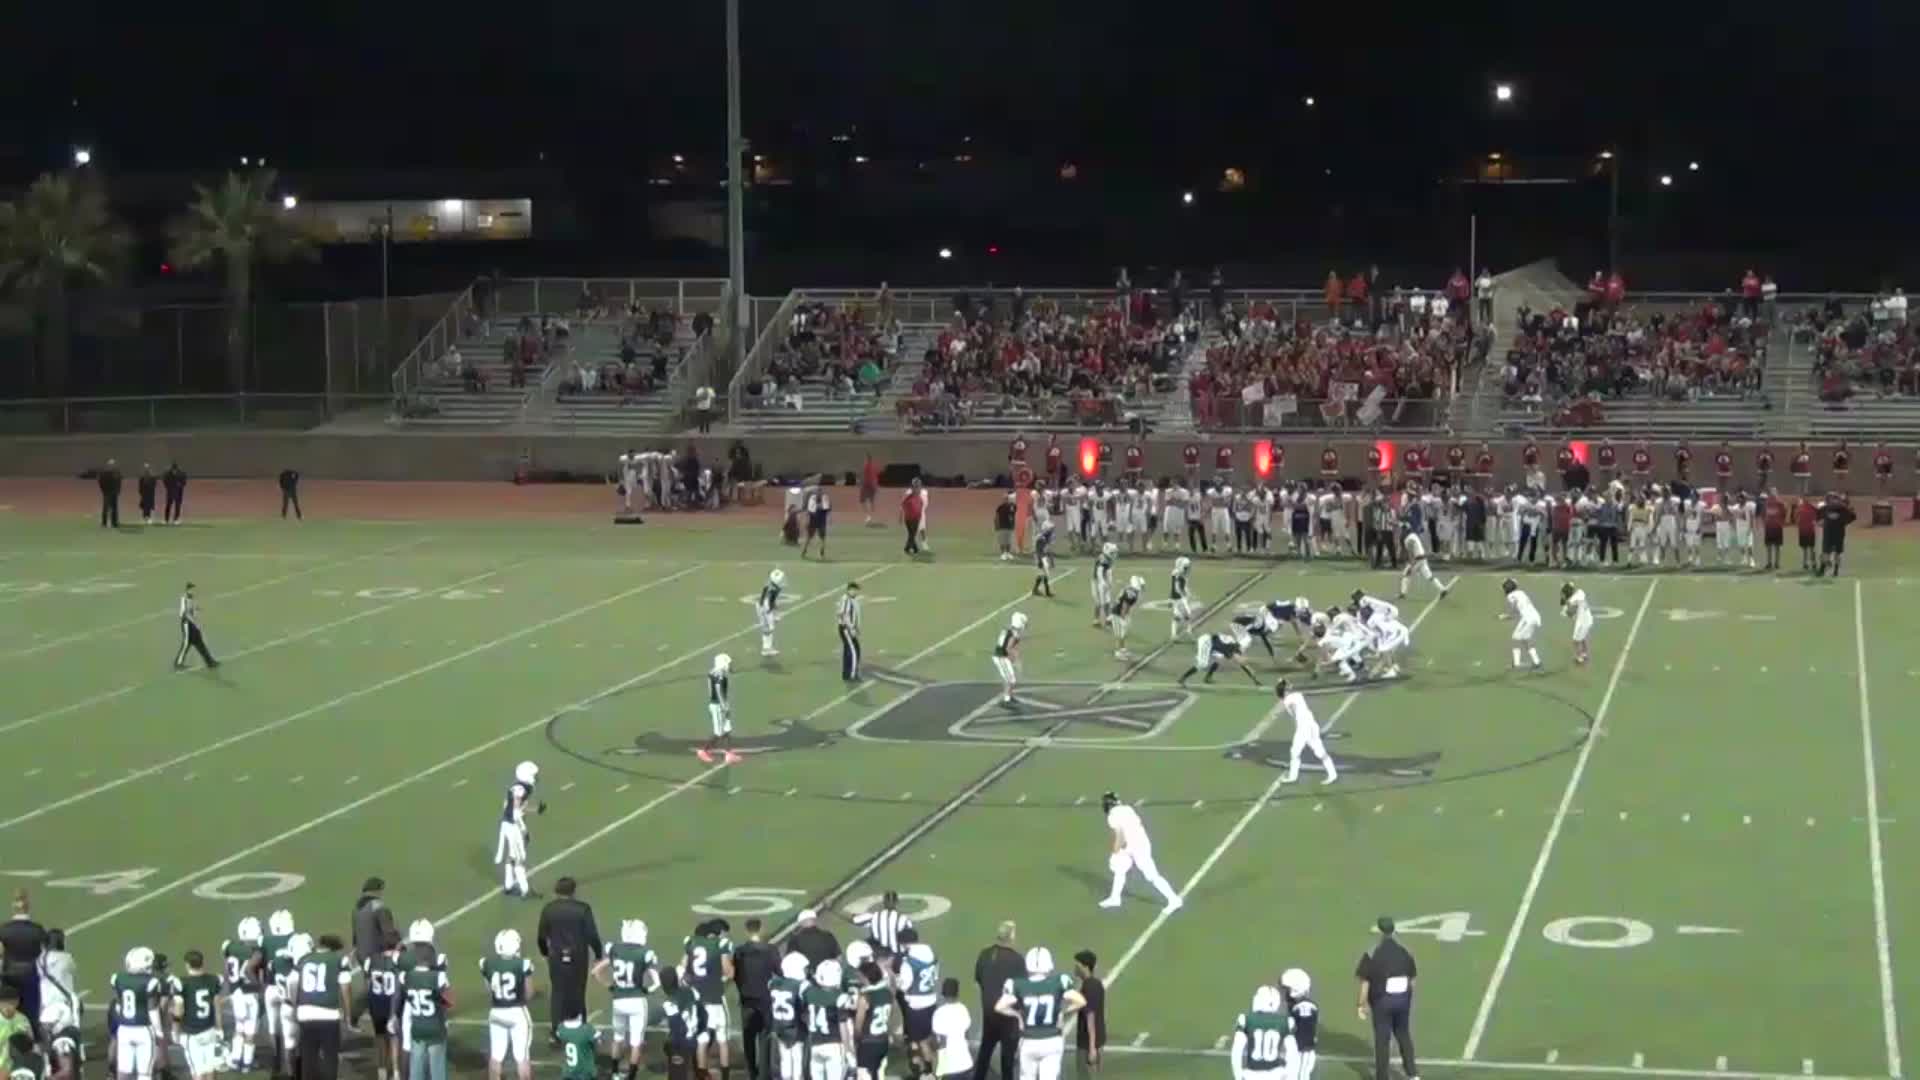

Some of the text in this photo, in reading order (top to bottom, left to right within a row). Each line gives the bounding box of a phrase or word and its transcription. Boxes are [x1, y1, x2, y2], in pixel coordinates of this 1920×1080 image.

[44, 867, 306, 899] 40
[691, 887, 952, 922] 50
[1369, 911, 1654, 948] 40
[613, 959, 635, 988] 21
[692, 946, 707, 976] 2
[302, 962, 326, 992] 61
[371, 970, 395, 996] 50
[196, 989, 210, 1018] 5
[1023, 995, 1054, 1025] 77
[808, 1004, 831, 1034] 14
[565, 1042, 578, 1066] 9
[1252, 1029, 1280, 1062] 10
